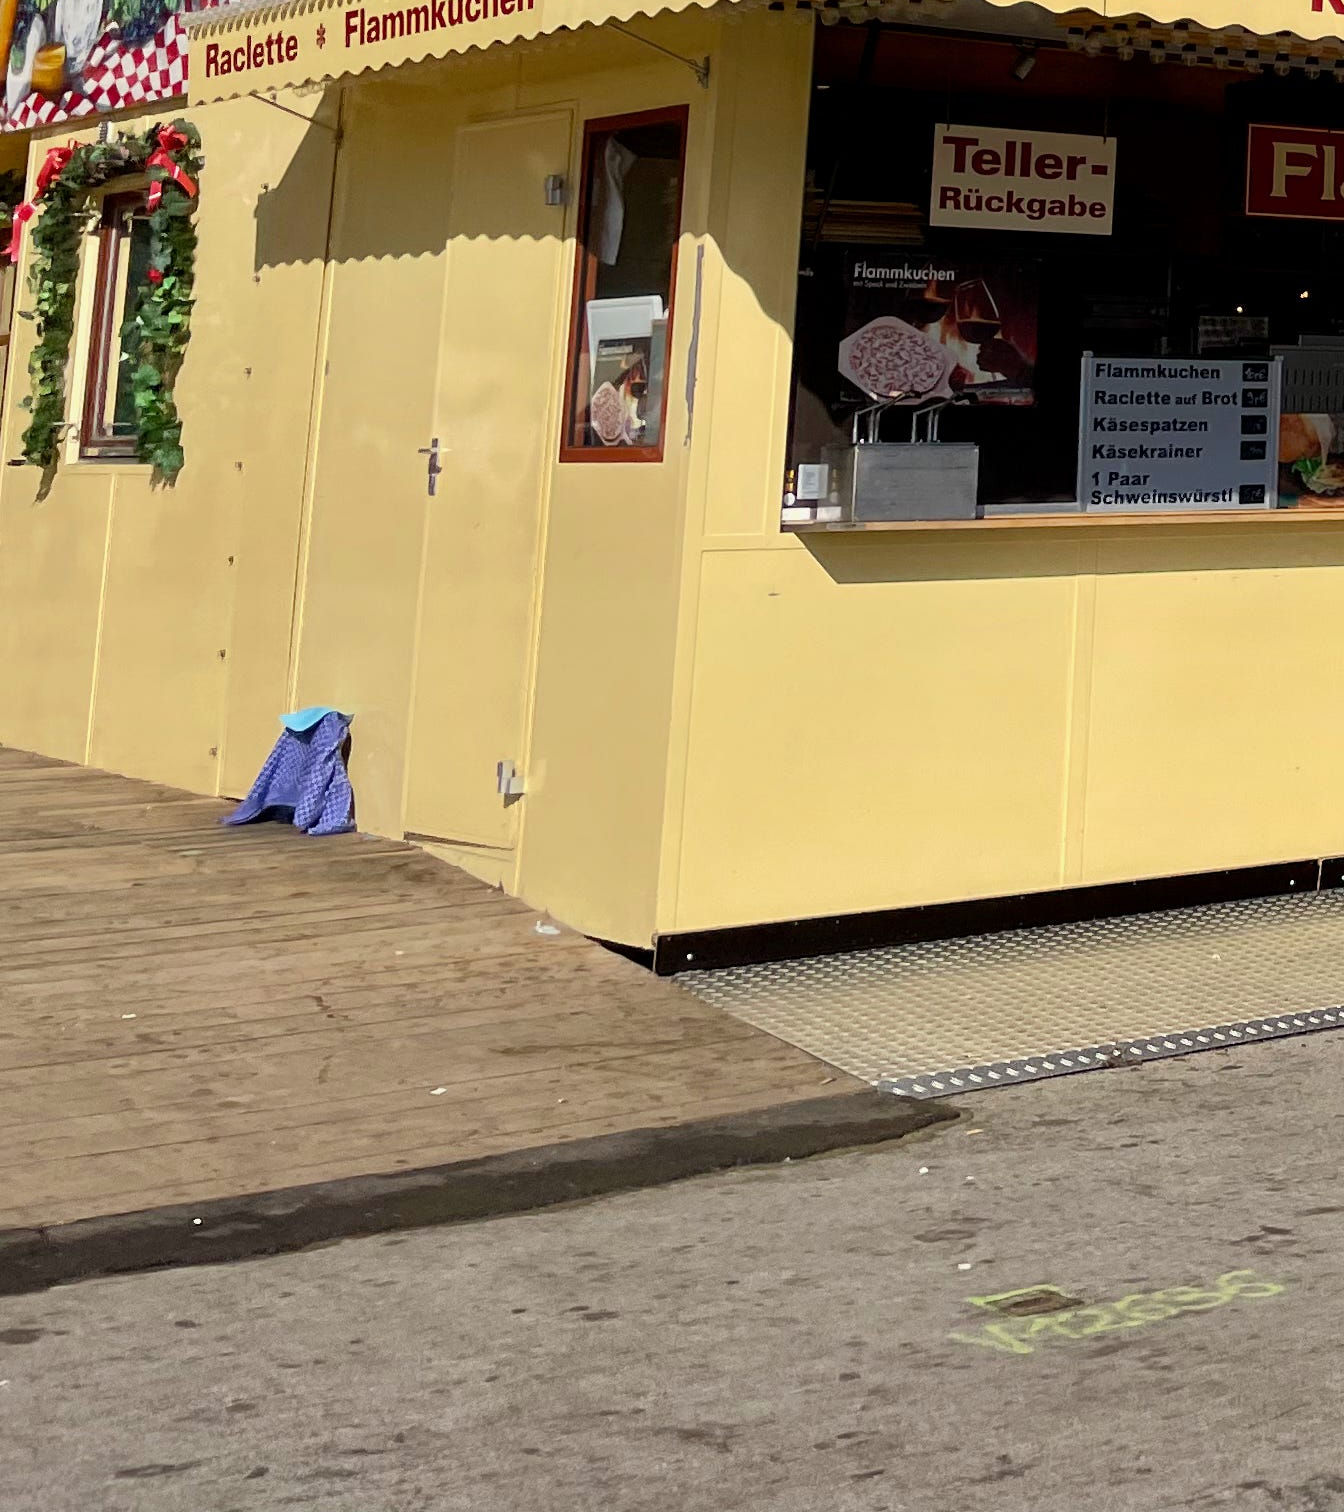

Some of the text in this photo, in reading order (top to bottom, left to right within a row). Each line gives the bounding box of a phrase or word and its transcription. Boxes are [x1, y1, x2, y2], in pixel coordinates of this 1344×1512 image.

[205, 32, 298, 78] Raclette
[943, 136, 1108, 181] Teller-
[939, 186, 1107, 221] Rückgabe
[854, 261, 955, 281] Flammkuchen
[1095, 362, 1221, 379] Flammkuchen
[1094, 390, 1171, 406] Raclette
[1175, 393, 1198, 405] auf
[1202, 390, 1239, 406] Brot
[1092, 416, 1209, 435] Käsespatzen
[1092, 443, 1203, 459] Käsekrainer
[1091, 471, 1150, 486] 1 Paar
[1091, 488, 1234, 505] Schweinswürstl
